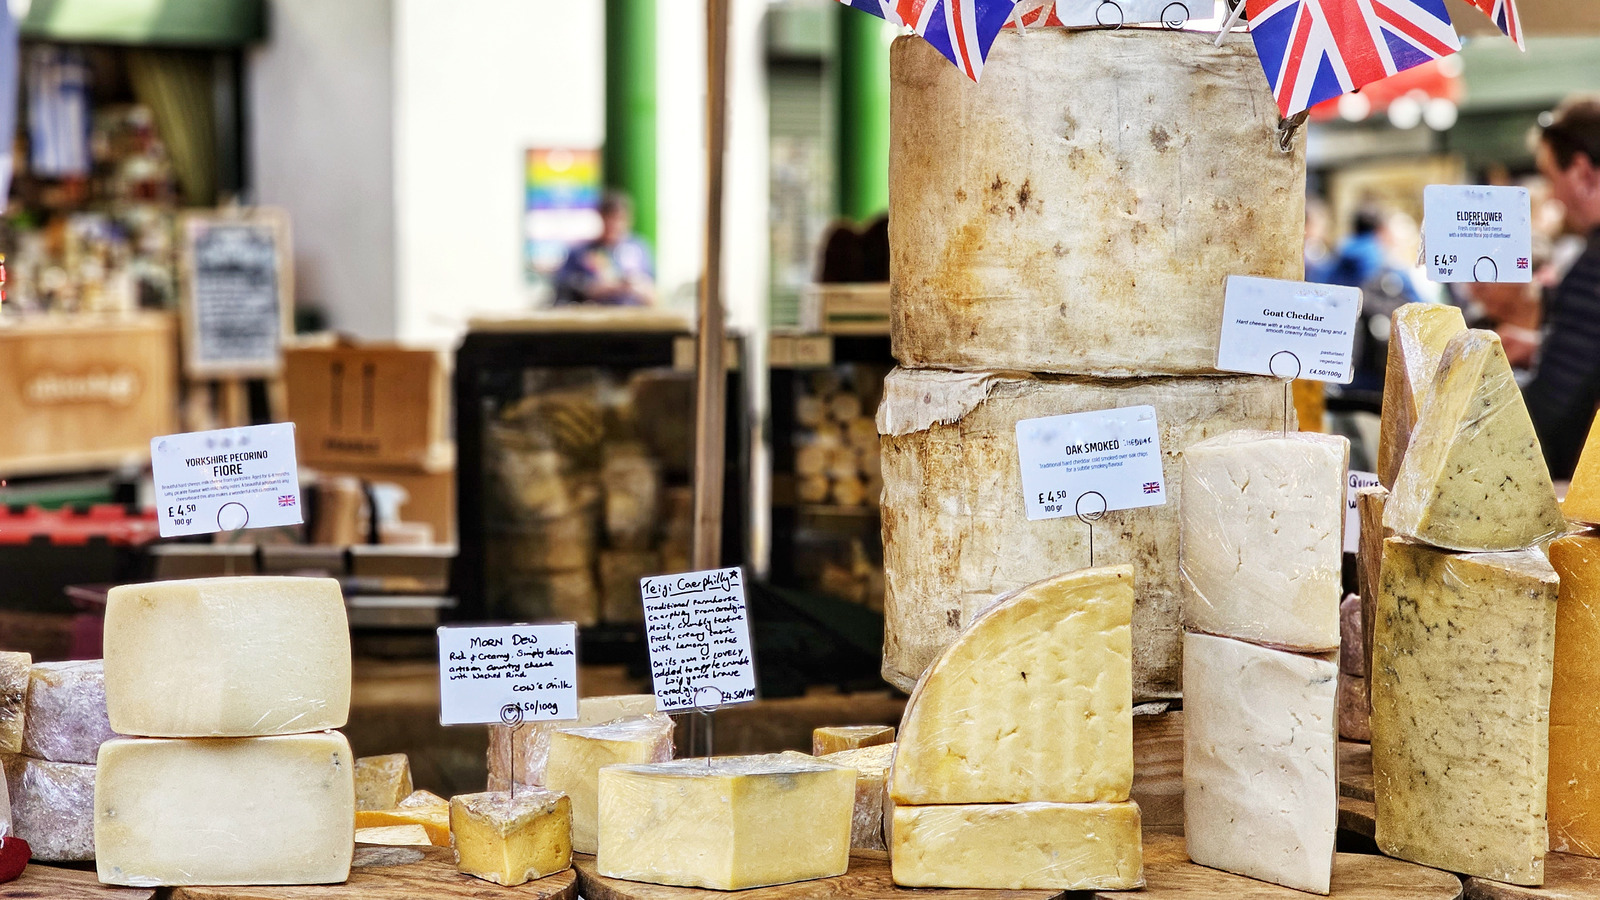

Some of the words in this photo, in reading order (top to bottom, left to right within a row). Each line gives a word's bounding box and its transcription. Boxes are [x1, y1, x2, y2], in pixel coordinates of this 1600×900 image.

[1456, 211, 1502, 221] ELDERFLOWER
[1435, 255, 1439, 265] £
[1442, 254, 1457, 266] 4.50
[1263, 309, 1284, 318] Goat
[1286, 311, 1324, 321] Cheddar
[1310, 368, 1342, 378] £4.50/100g
[1065, 445, 1083, 455] OAK
[1085, 440, 1120, 453] SMOKED
[1123, 437, 1152, 446] HEDDAR
[185, 454, 228, 467] YORKSHIRE
[230, 450, 268, 462] PECORINO
[213, 464, 243, 477] FIORE
[1038, 493, 1044, 504] £
[1047, 490, 1066, 503] 4.50
[168, 506, 174, 517] £
[177, 504, 196, 517] 4.50
[186, 518, 192, 526] gr
[677, 572, 730, 592] Caerphilly
[646, 599, 689, 611] Traditional
[652, 644, 671, 652] with
[714, 637, 737, 645] notes
[450, 651, 466, 661] Rich
[517, 646, 544, 658] Simply
[665, 657, 676, 666] its
[714, 648, 743, 660] LOVELY
[654, 665, 682, 678] added
[694, 660, 720, 674] apple
[713, 670, 740, 678] brave
[663, 697, 693, 706] Wales
